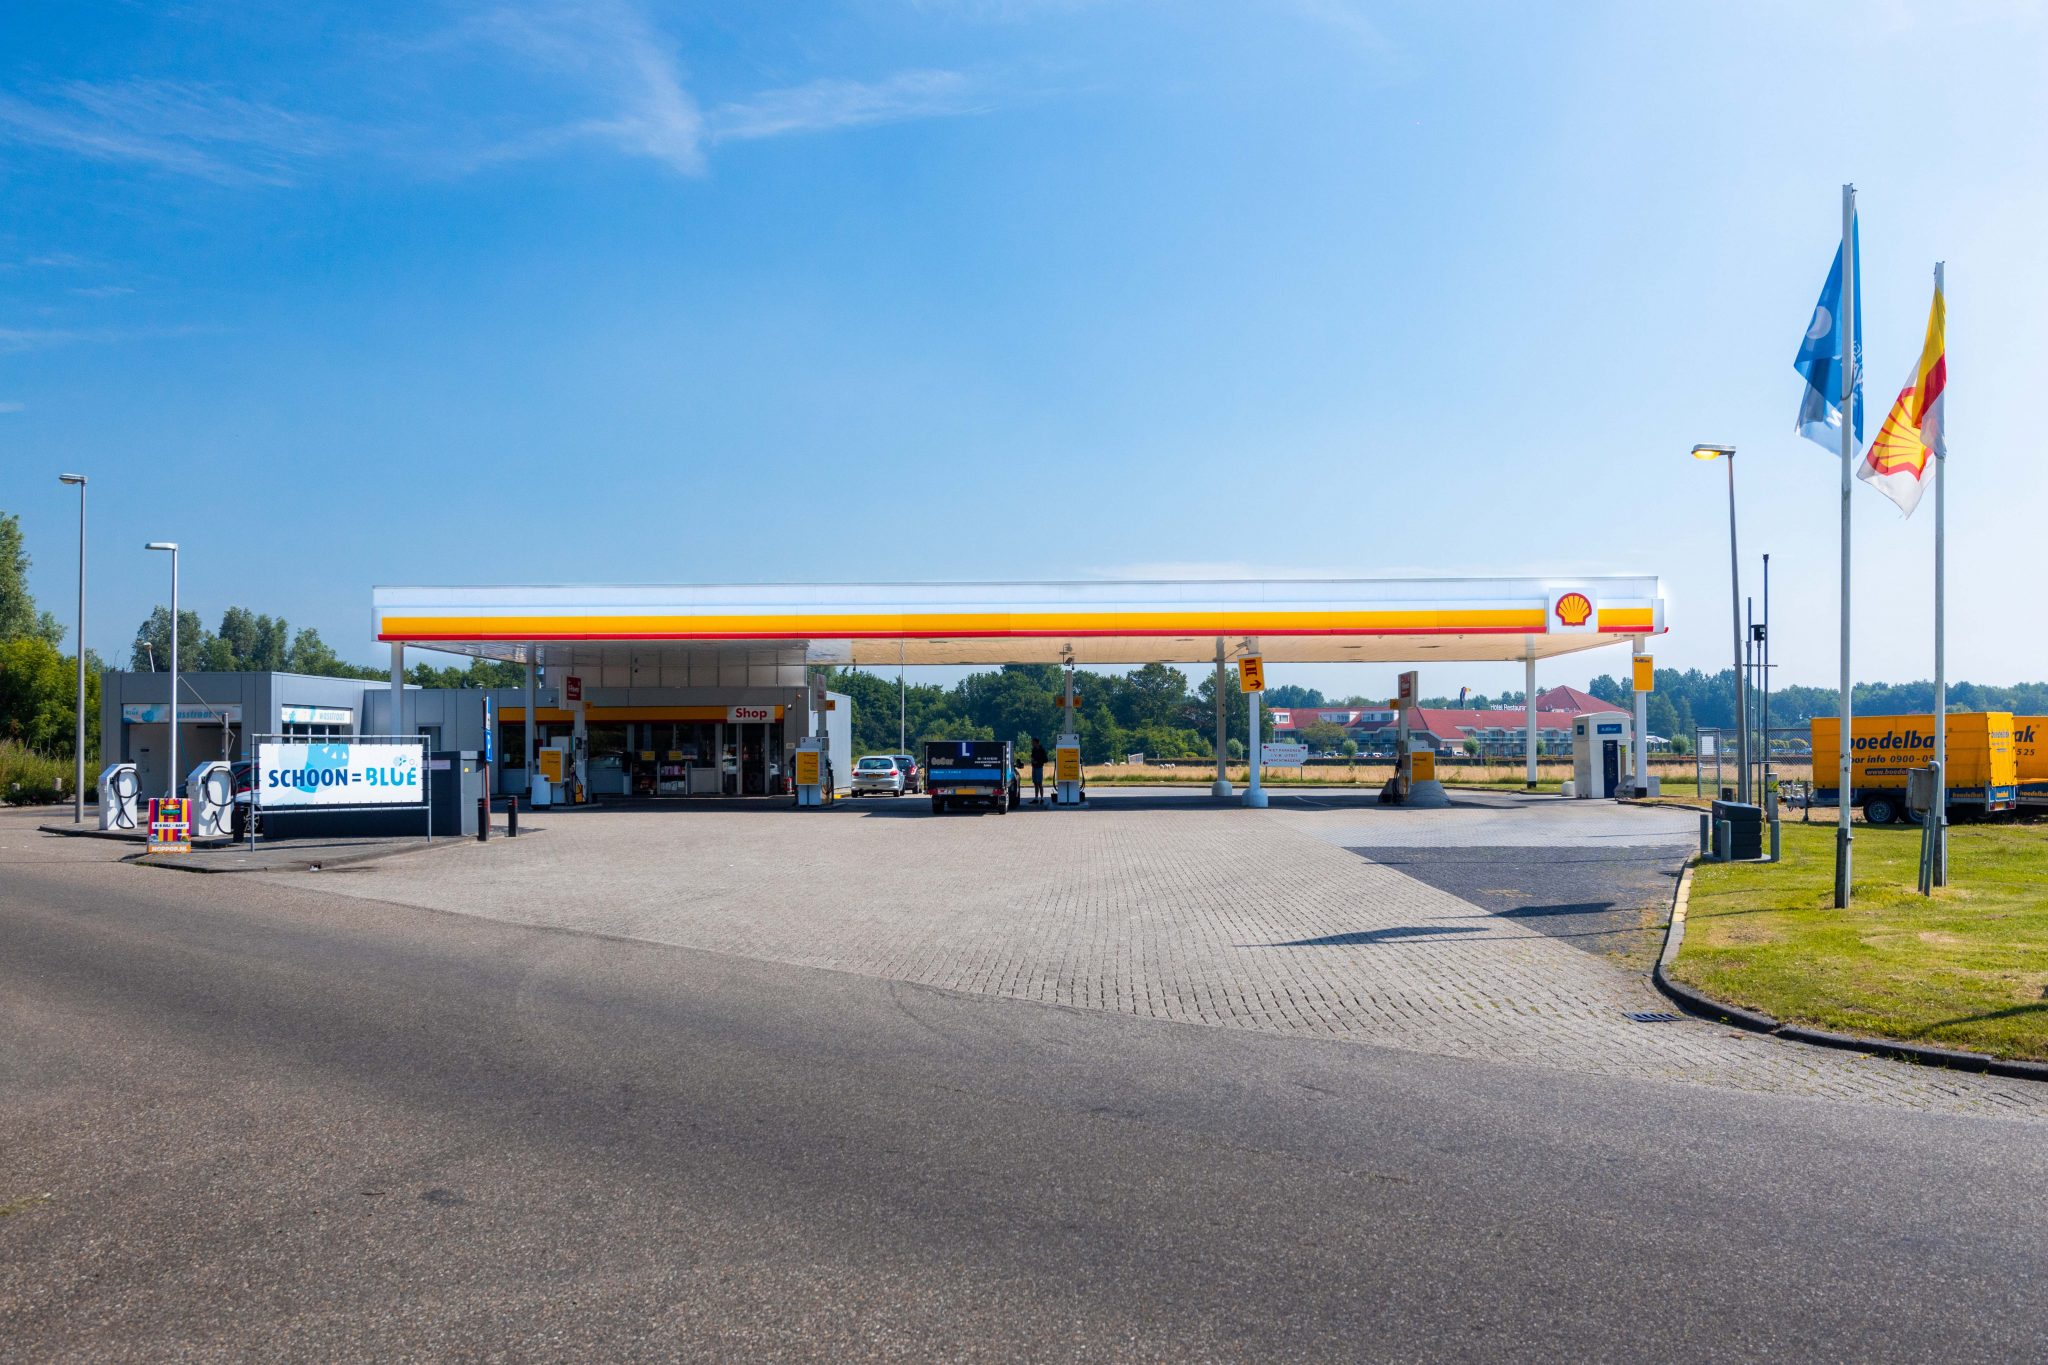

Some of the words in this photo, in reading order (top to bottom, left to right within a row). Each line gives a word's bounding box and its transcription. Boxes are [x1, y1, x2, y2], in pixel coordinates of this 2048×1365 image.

[735, 707, 768, 721] Shop
[961, 742, 971, 757] L
[1867, 754, 1886, 763] info
[268, 768, 348, 788] SCHOON
[351, 773, 362, 782] =
[365, 767, 417, 786] BLUE
